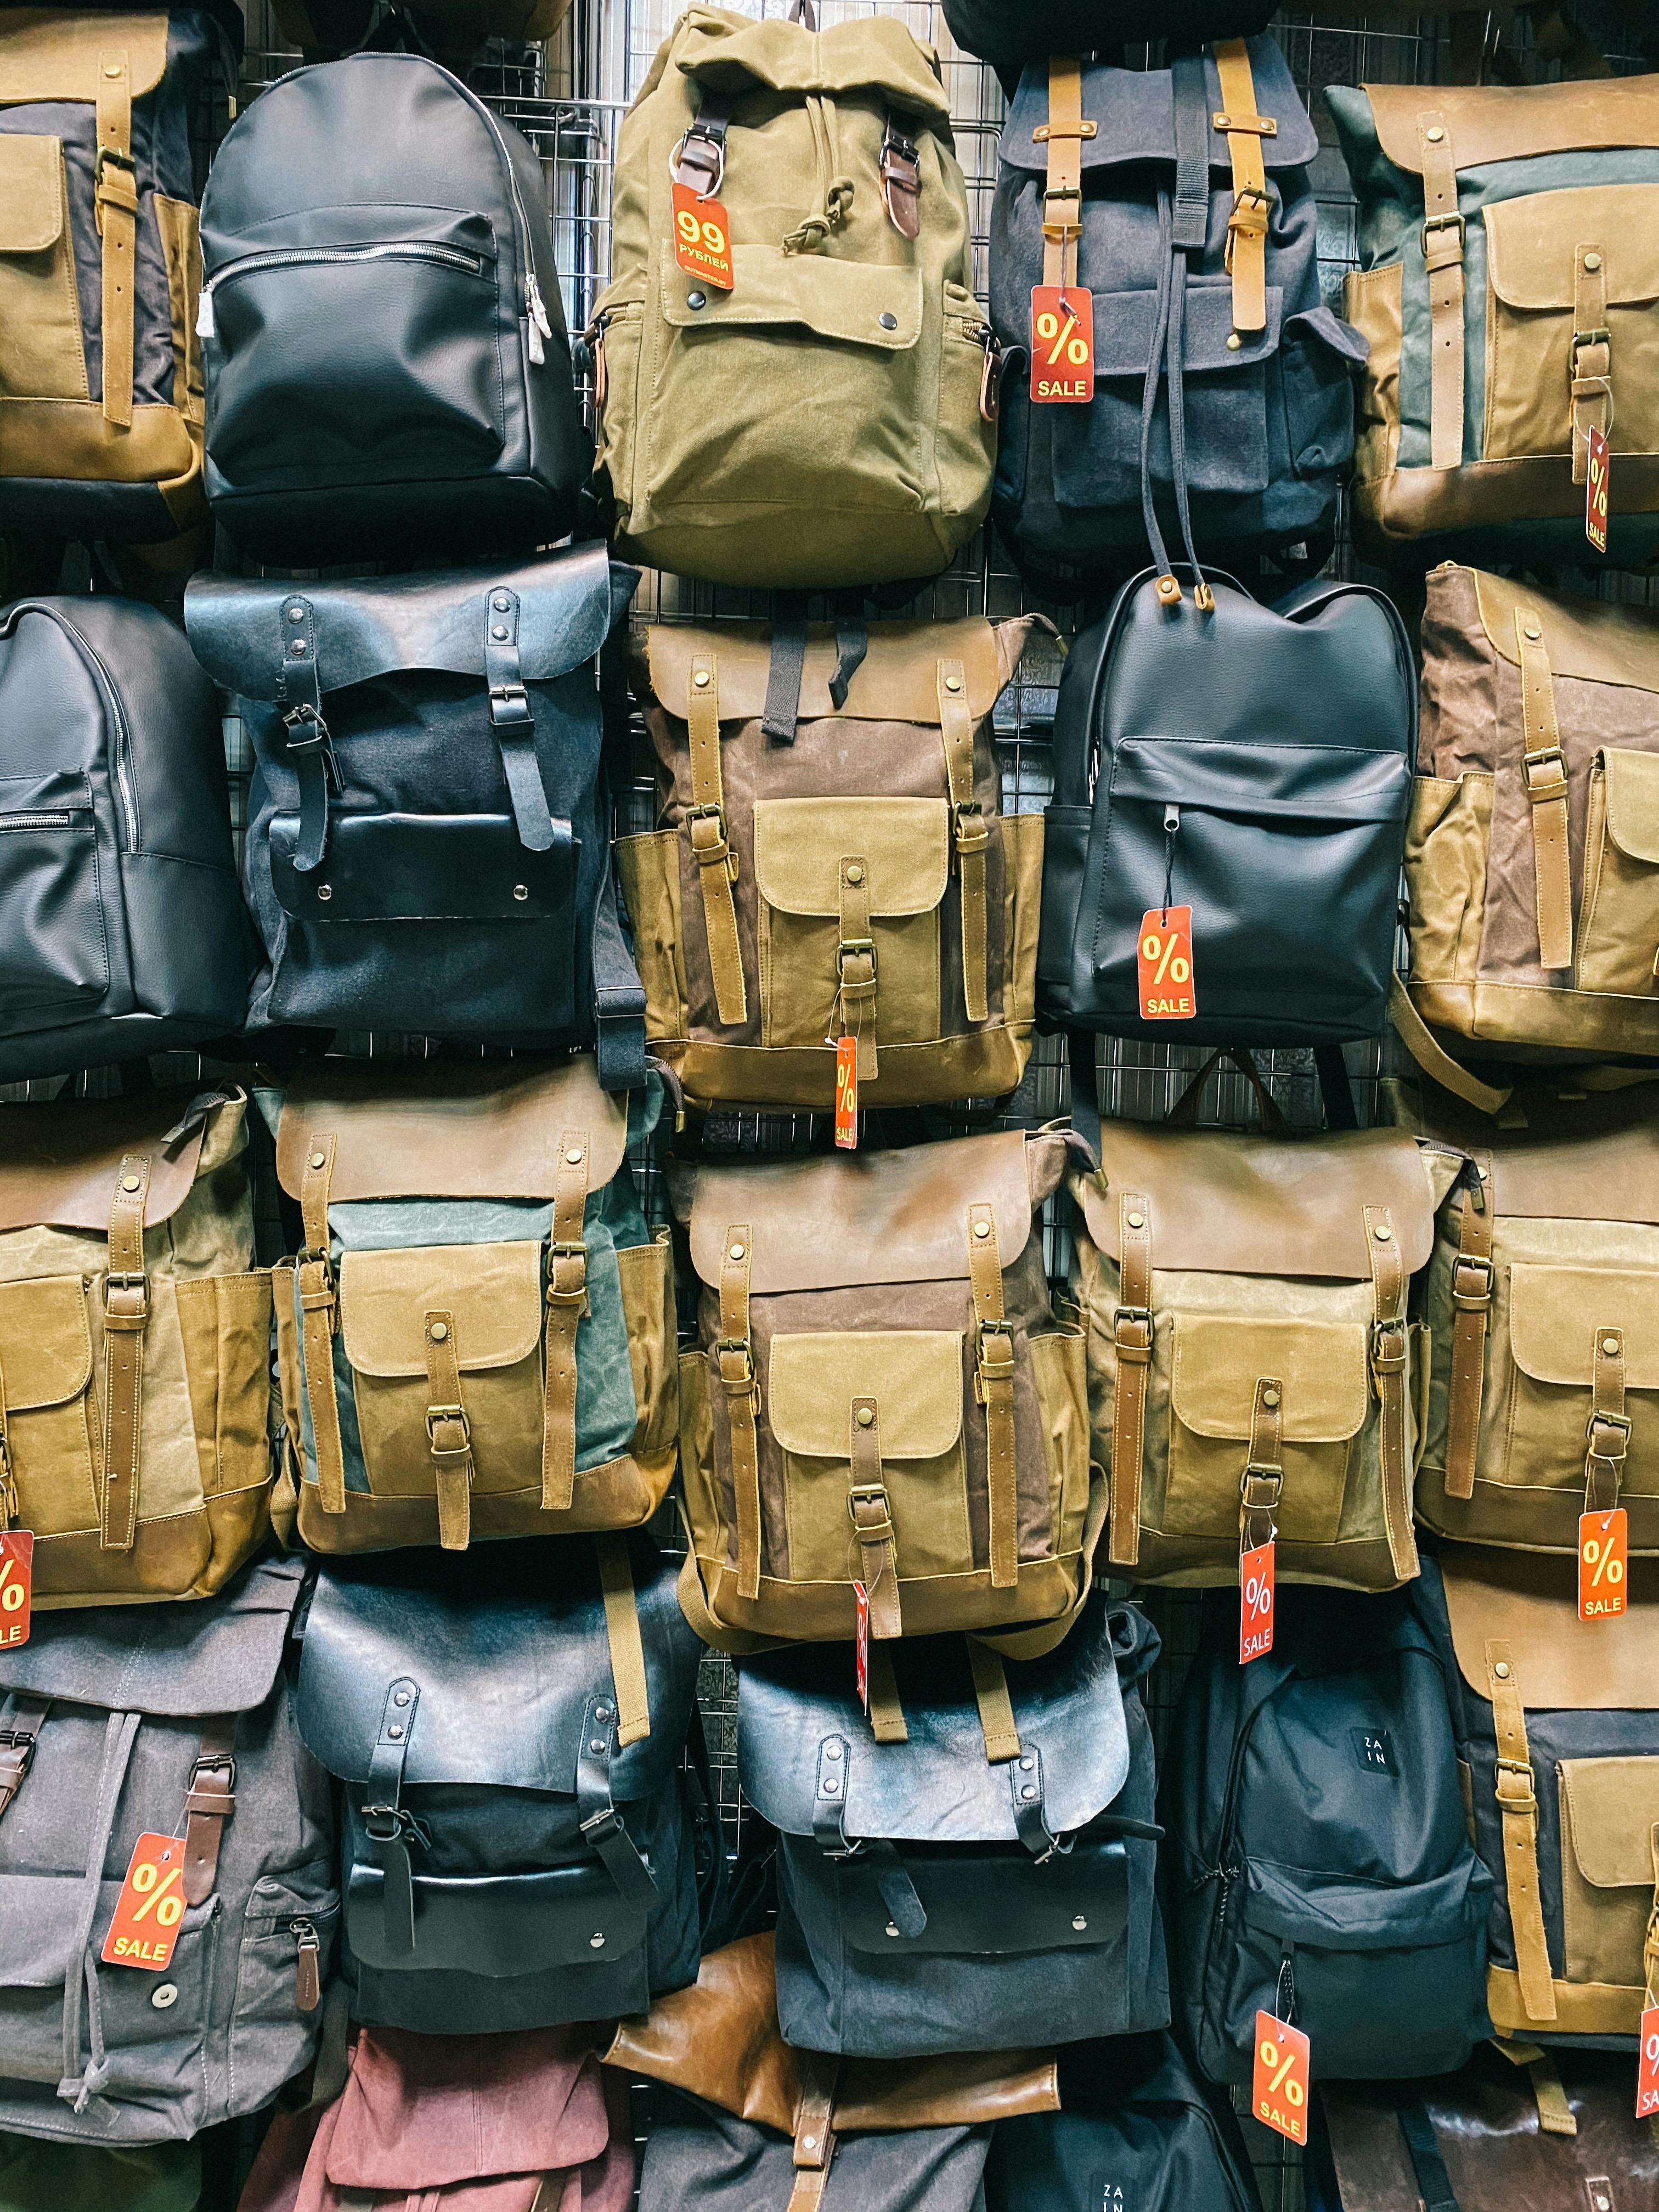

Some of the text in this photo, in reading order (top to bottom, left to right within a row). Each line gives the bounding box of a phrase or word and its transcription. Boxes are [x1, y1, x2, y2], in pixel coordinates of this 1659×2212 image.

[677, 211, 725, 253] 99
[679, 243, 729, 272] РУБЛЕЙ
[1037, 313, 1088, 364] %
[1037, 380, 1086, 396] SALE
[1590, 458, 1606, 517] %
[1589, 522, 1605, 547] SALE
[1142, 933, 1189, 984] %
[1147, 997, 1190, 1013] SALE
[837, 1063, 854, 1113] %
[837, 1126, 853, 1142] SALE
[1583, 1537, 1623, 1587] %
[1246, 1572, 1271, 1621] %
[1585, 1597, 1622, 1616] SALE
[0, 1625, 21, 1644] LE
[1244, 1628, 1271, 1657] SALE
[1364, 1737, 1382, 1750] ZA
[1367, 1751, 1385, 1764] IN
[132, 1863, 182, 1926] %
[113, 1937, 168, 1962] SALE
[1260, 2041, 1304, 2107] %
[1642, 2089, 1659, 2110] SA
[1260, 2101, 1300, 2137] SALE
[1104, 2185, 1123, 2199] ZA
